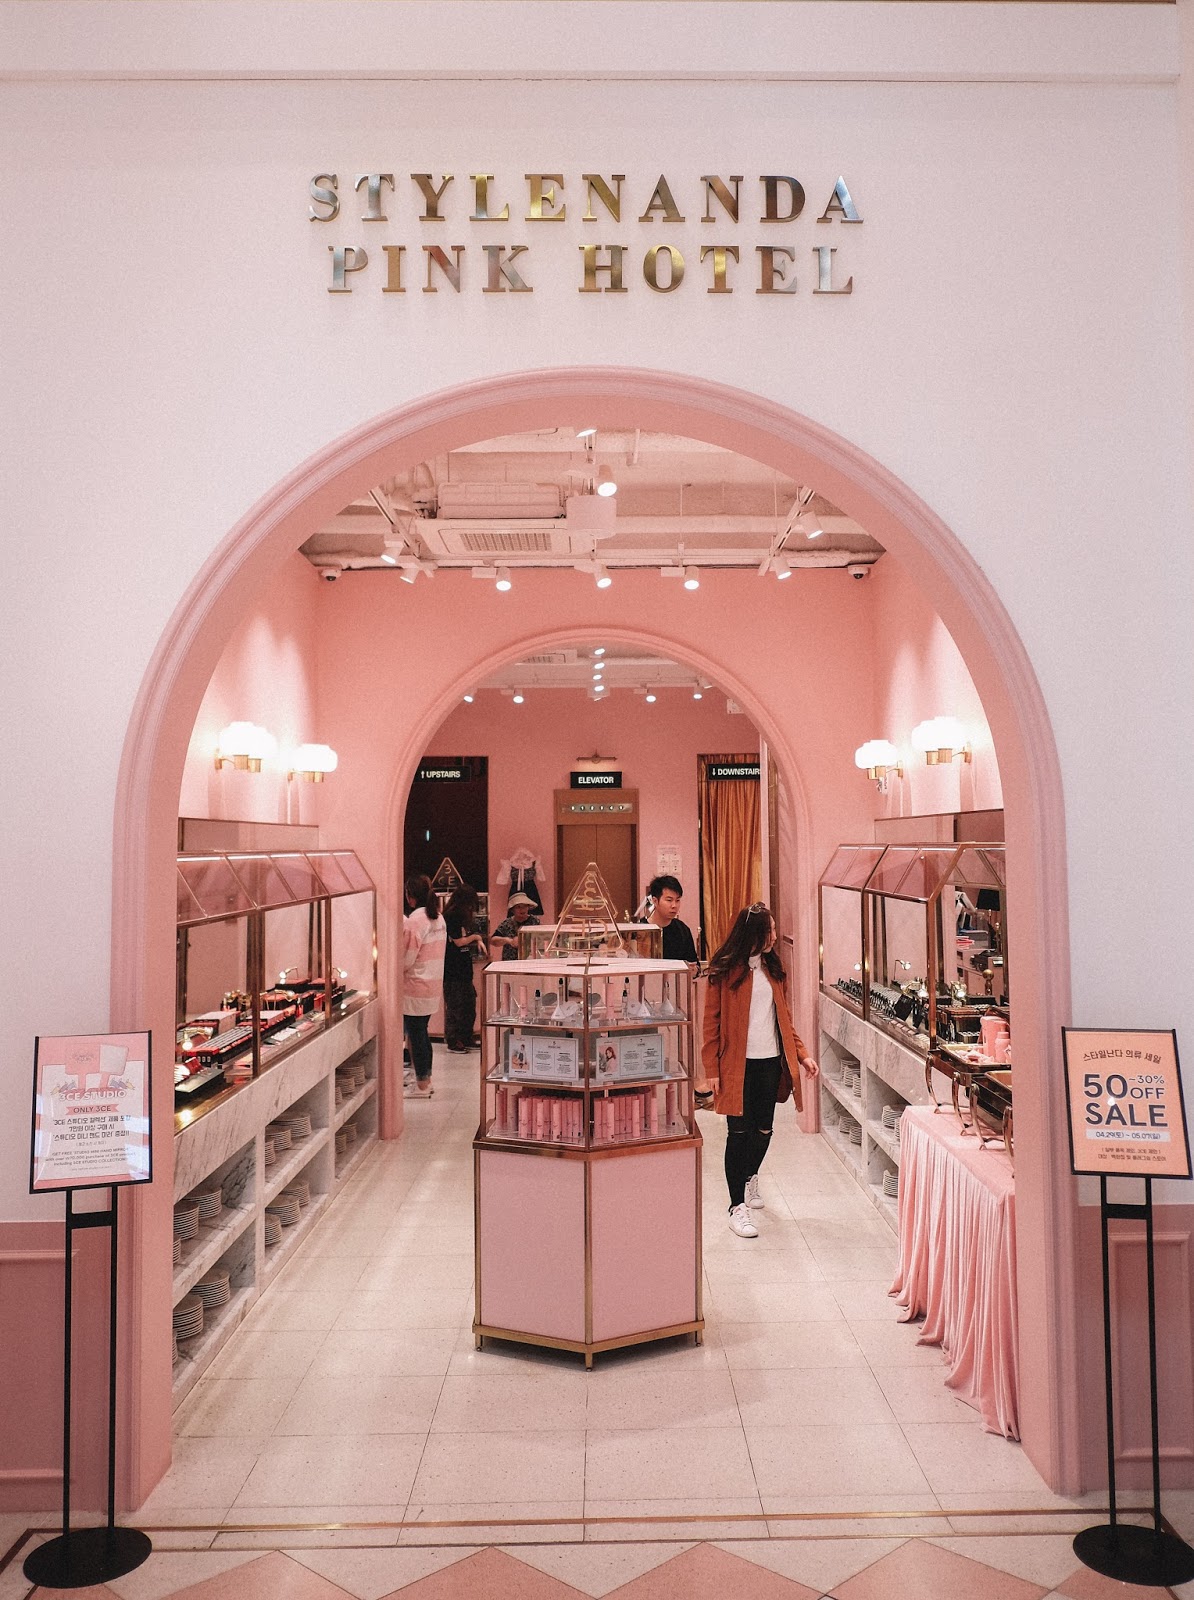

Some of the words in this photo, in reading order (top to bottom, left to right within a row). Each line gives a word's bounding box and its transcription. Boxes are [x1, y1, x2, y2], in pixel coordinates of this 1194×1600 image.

[308, 172, 864, 224] STYLENANDA
[327, 244, 534, 294] PINK
[578, 244, 853, 294] HOTEL
[426, 770, 461, 778] UPSTAIRS
[717, 768, 761, 776] DOWNSTAIR
[578, 776, 614, 784] ELEVATOR
[1083, 1049, 1123, 1061] 스타일난다
[1126, 1049, 1142, 1059] 의류
[1144, 1052, 1162, 1064] 세일
[1084, 1073, 1128, 1099] 50
[59, 1092, 81, 1102] 3CE
[83, 1090, 127, 1100] STUDIO
[1130, 1087, 1165, 1099] OFF
[73, 1106, 94, 1114] ONLY
[1085, 1102, 1168, 1127] SALE
